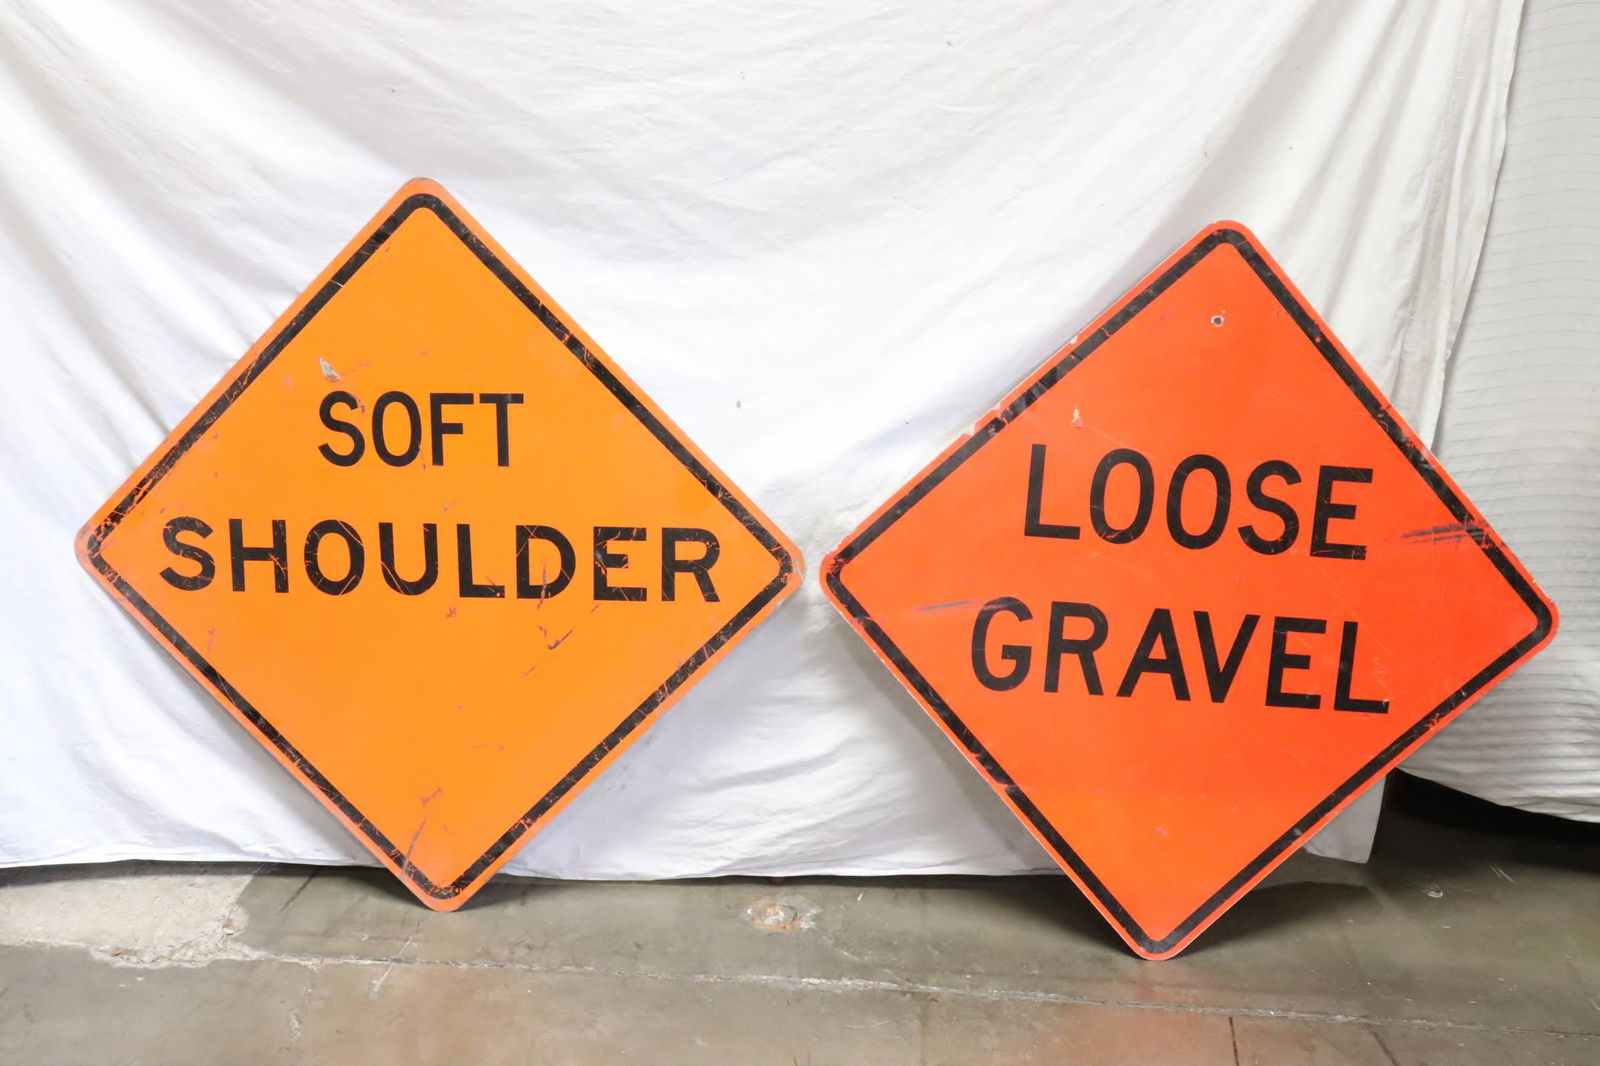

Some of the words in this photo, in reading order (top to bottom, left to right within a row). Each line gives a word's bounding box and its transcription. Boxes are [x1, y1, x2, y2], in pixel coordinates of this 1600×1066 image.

[319, 391, 524, 467] SOFT
[1024, 444, 1374, 561] LOOSE
[160, 517, 720, 602] SHOULDER
[971, 597, 1389, 714] GRAVEL
